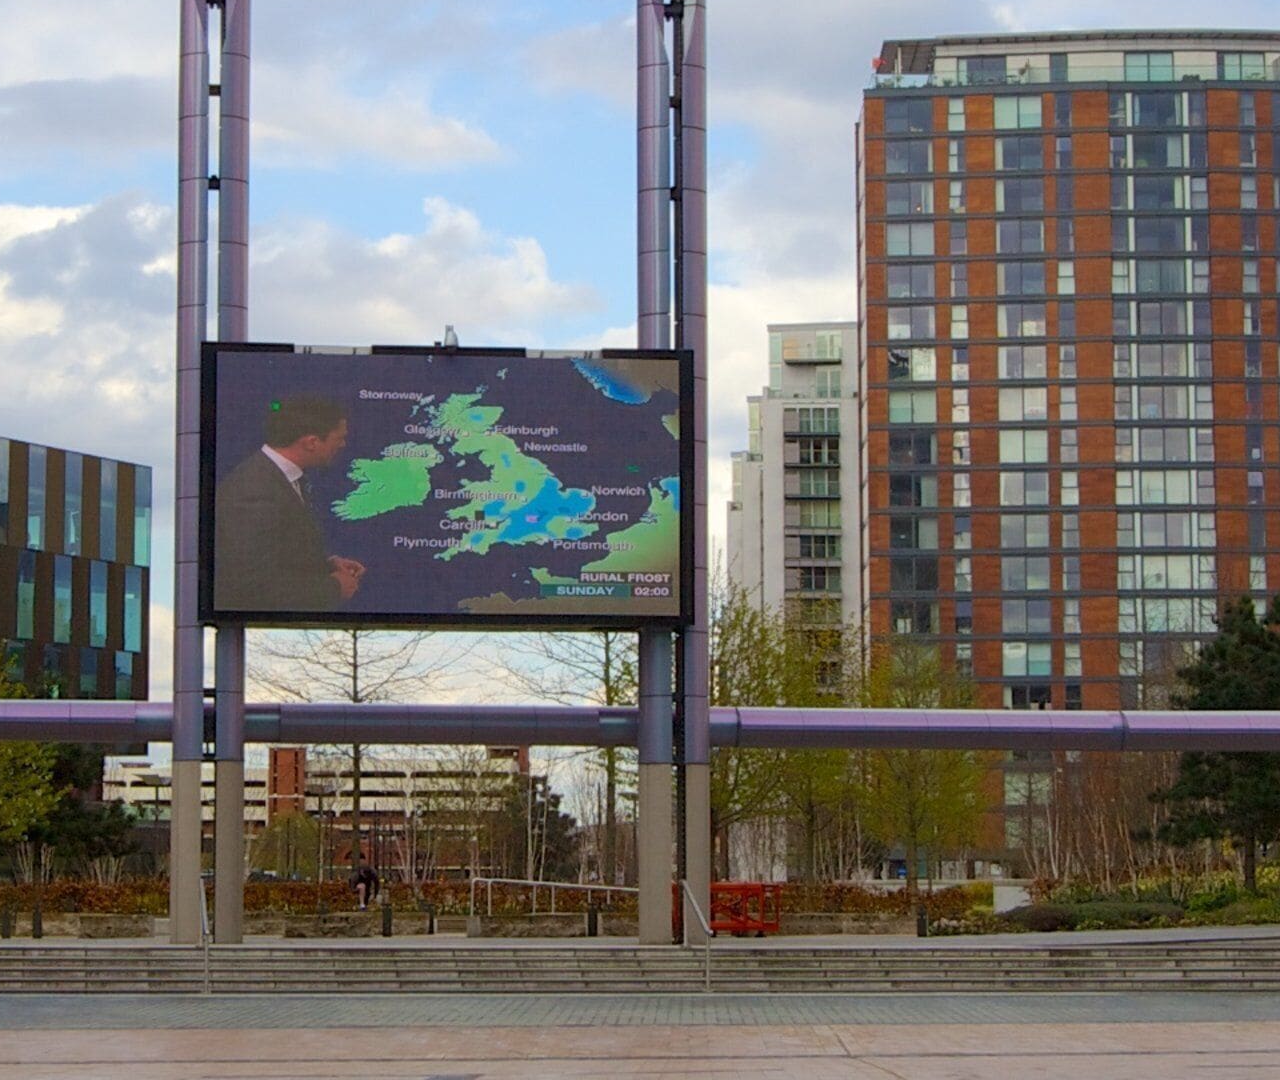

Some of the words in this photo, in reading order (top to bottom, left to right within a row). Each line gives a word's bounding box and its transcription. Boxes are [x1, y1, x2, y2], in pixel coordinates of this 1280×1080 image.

[359, 389, 423, 402] Stornoway
[404, 424, 460, 438] Glasgow
[494, 424, 558, 438] Edinburgh
[524, 441, 588, 453] Newcastle
[434, 489, 518, 502] Birmingham
[592, 485, 646, 497] Norwich
[577, 510, 629, 522] London
[439, 519, 486, 531] Cardiff
[394, 536, 461, 550] Plymouth
[553, 539, 636, 552] Portsmouth
[580, 572, 625, 583] RURAL
[628, 572, 671, 584] FROST
[556, 585, 614, 596] SUNDAY
[634, 586, 669, 596] 02:00
